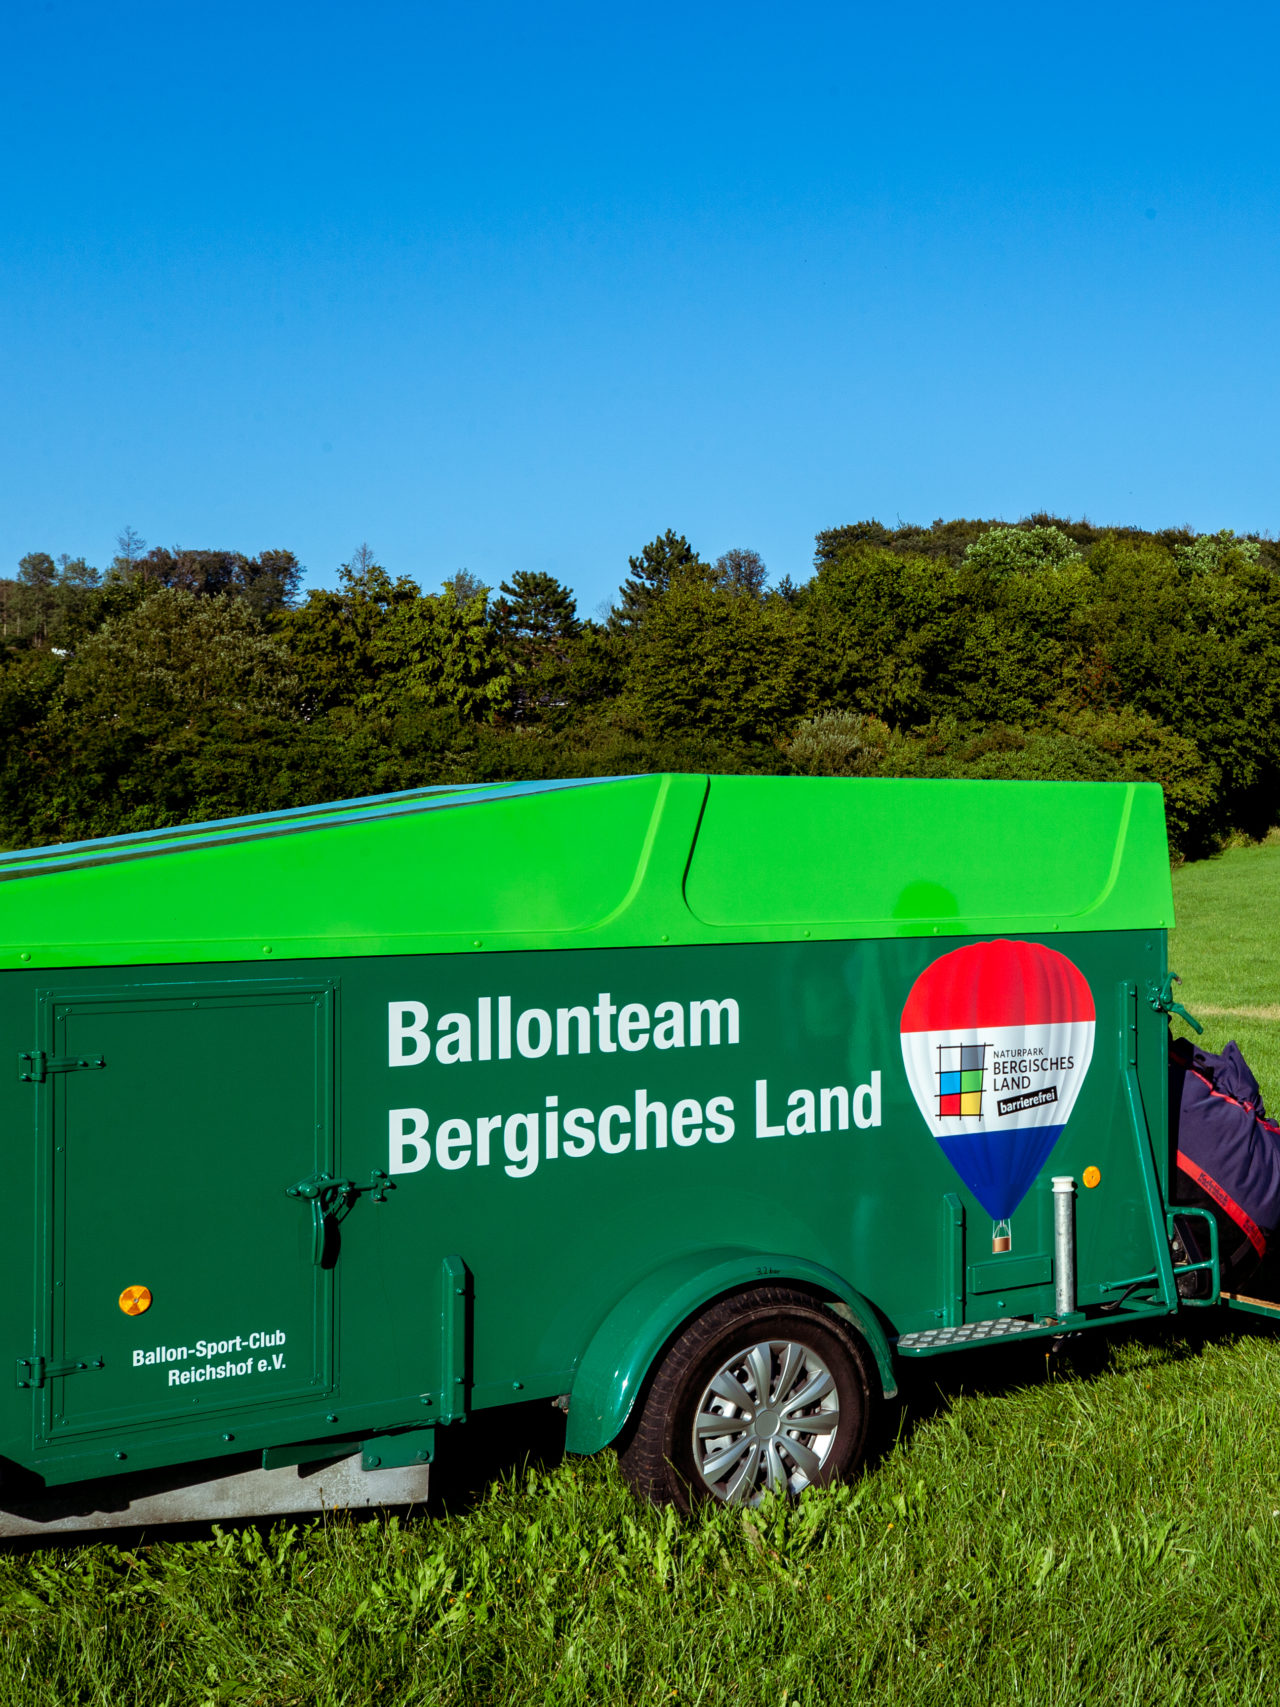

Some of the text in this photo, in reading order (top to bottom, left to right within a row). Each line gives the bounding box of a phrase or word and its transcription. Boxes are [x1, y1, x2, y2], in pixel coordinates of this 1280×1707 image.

[388, 993, 740, 1067] Ballonteam
[993, 1047, 1044, 1059] NATURPARK
[993, 1055, 1075, 1075] BERGISCHES
[993, 1076, 1031, 1092] LAND
[999, 1089, 1056, 1114] barrierefrei
[388, 1070, 883, 1178] Bergisches Land
[132, 1329, 287, 1367] Ballon-Sport-Club
[168, 1352, 287, 1387] Reichshof e.V.
